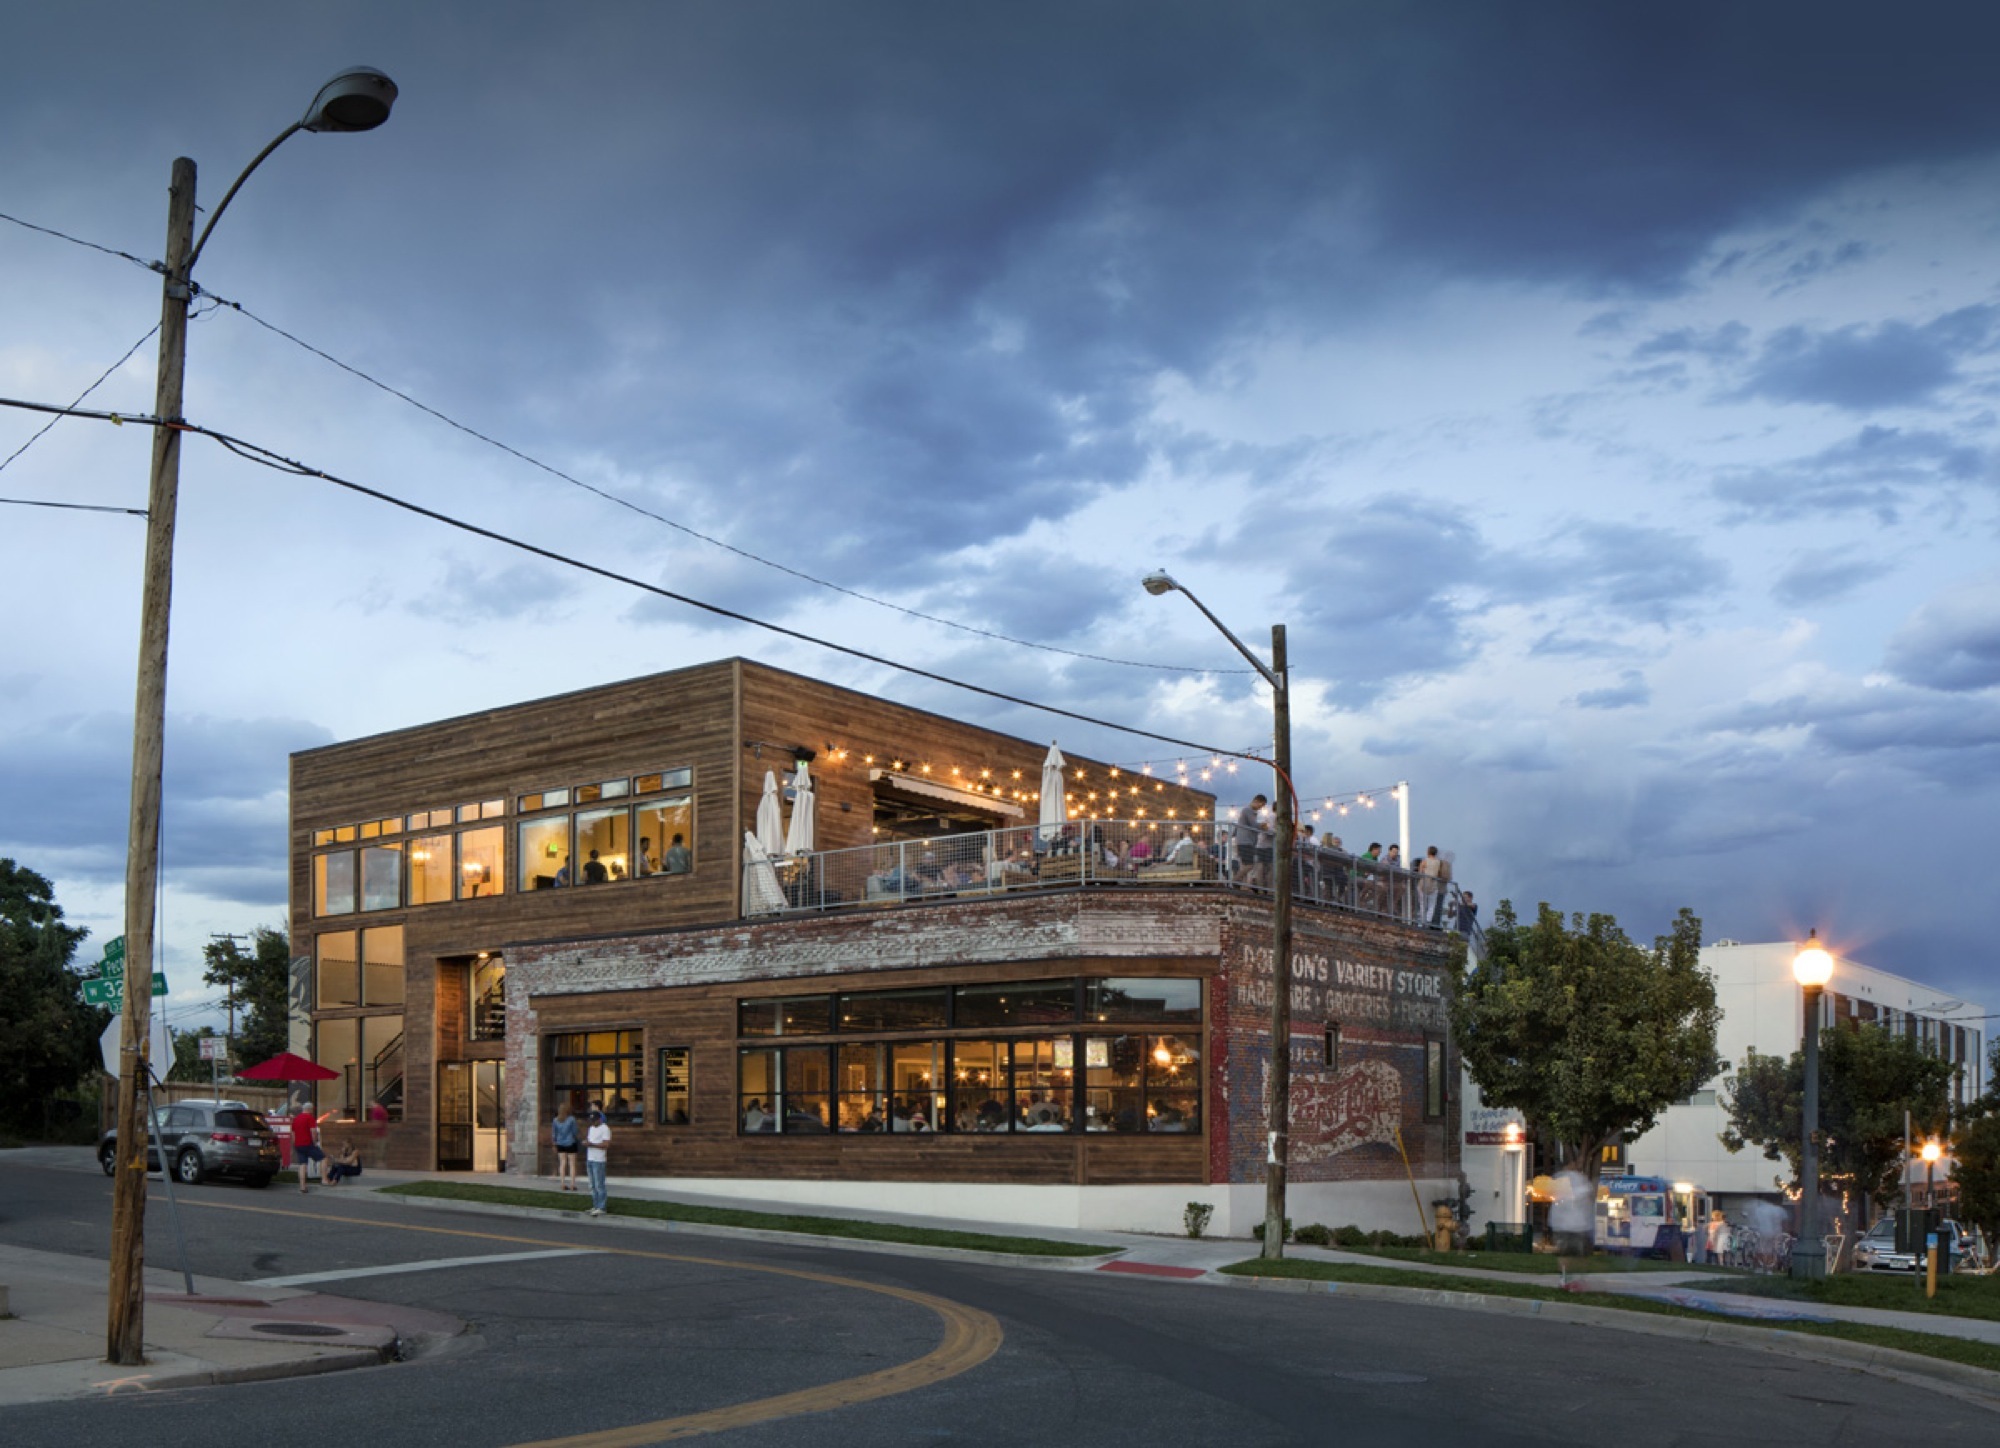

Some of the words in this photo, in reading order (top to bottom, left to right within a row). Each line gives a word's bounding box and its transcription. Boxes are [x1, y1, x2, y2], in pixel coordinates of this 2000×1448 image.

[104, 981, 123, 999] 32
[1336, 959, 1394, 991] VARIETY
[1397, 971, 1441, 998] STORE
